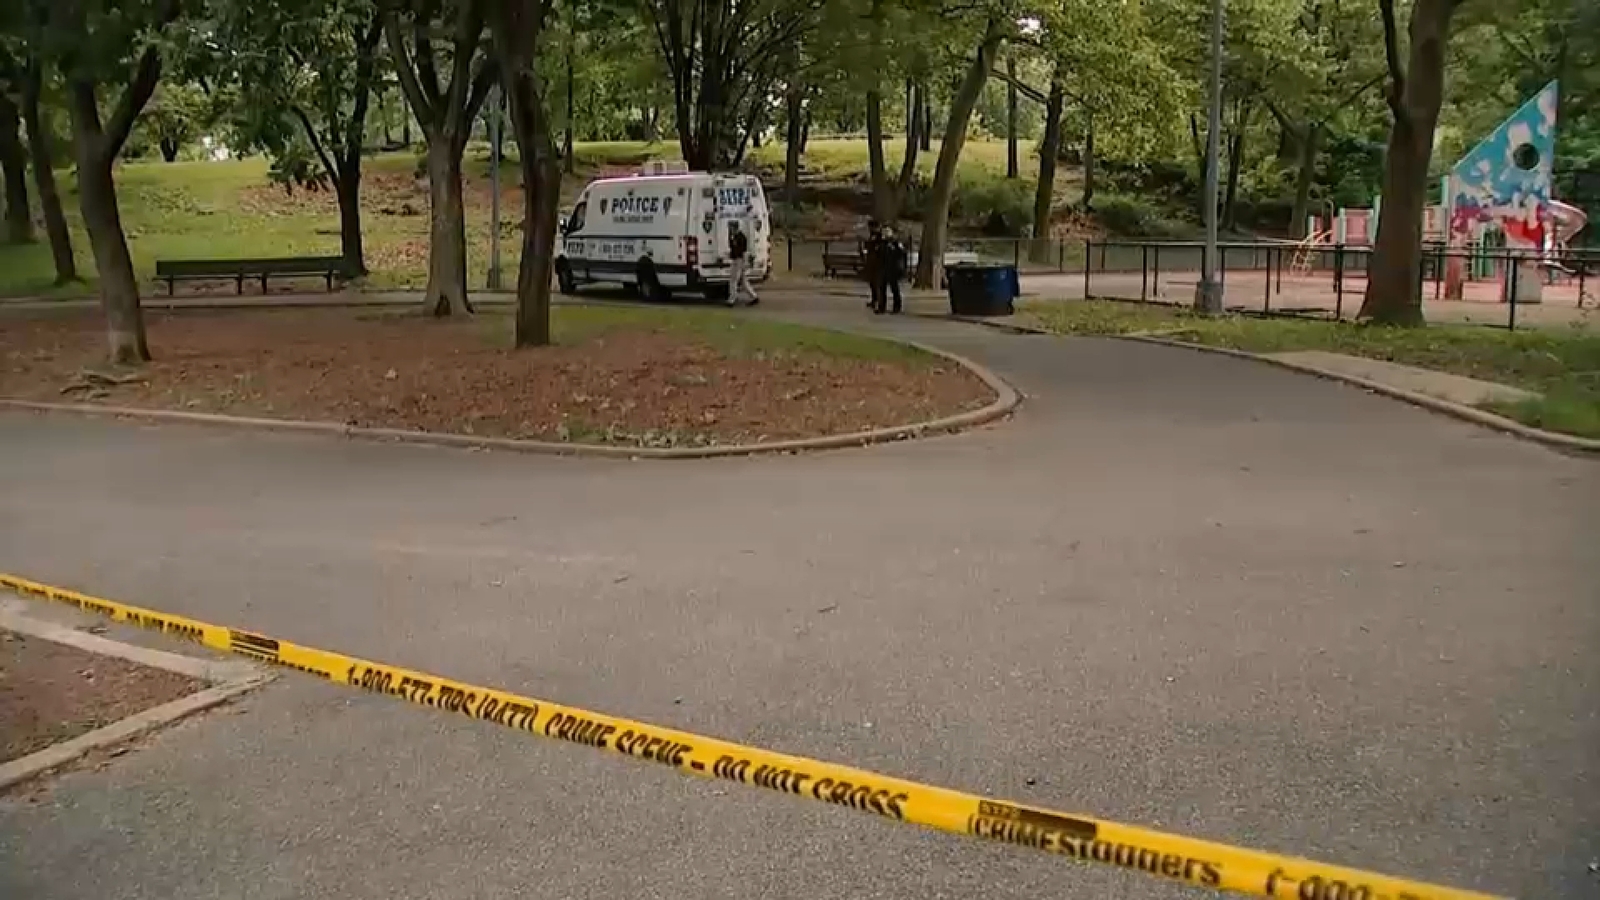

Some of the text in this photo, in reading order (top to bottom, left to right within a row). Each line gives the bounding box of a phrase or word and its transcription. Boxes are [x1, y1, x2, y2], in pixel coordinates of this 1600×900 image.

[611, 196, 659, 213] POLICE
[545, 712, 617, 748] CRIME
[615, 730, 694, 766] SCENE
[713, 755, 751, 784] DO
[753, 764, 811, 794] NOT
[812, 777, 909, 820] CROSS
